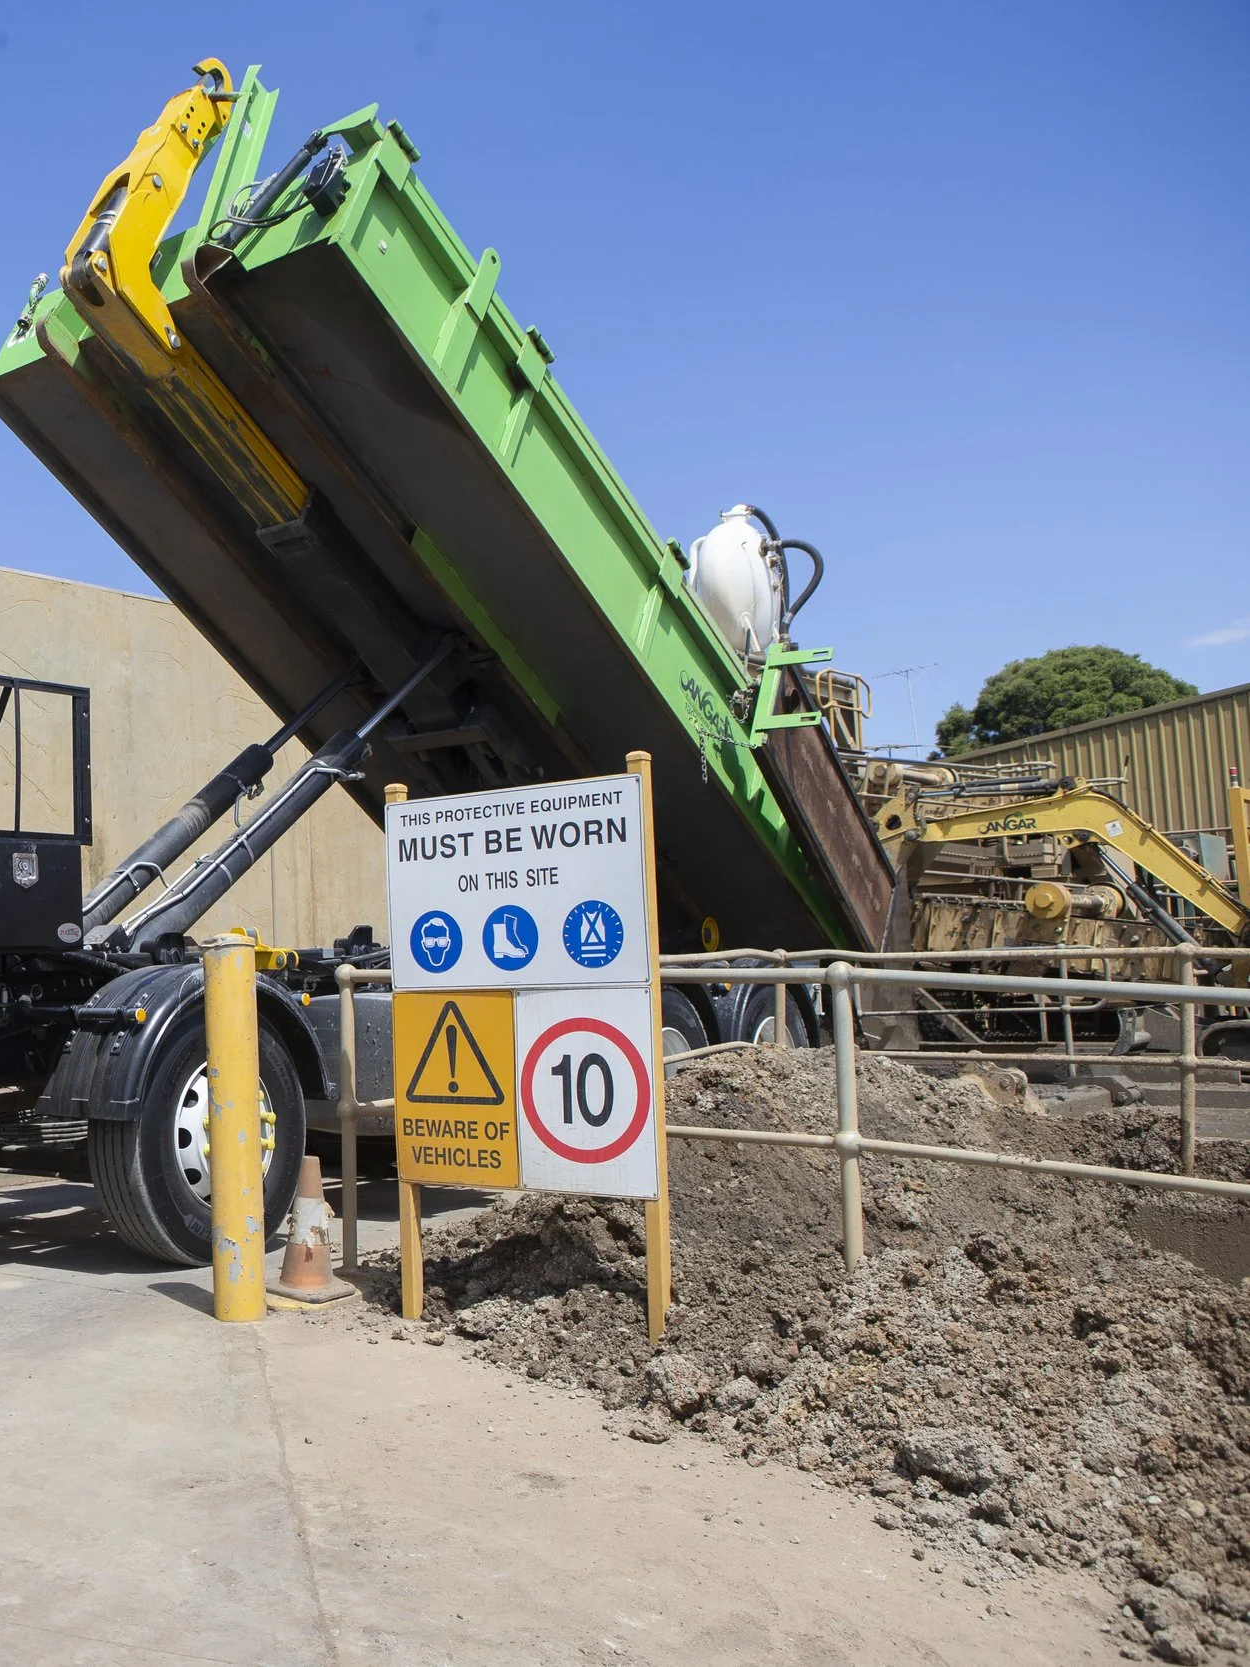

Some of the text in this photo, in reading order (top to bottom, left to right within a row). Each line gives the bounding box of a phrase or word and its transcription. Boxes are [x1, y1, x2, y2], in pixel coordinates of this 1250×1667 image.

[400, 791, 623, 827] THIS PROTECTIVE EQUIPMENT
[398, 817, 627, 862] MUST BE WORN
[458, 867, 559, 893] ON THIS SITE
[551, 1053, 614, 1128] 10
[403, 1118, 510, 1141] BEWARE OF
[411, 1145, 502, 1170] VEHICLES
